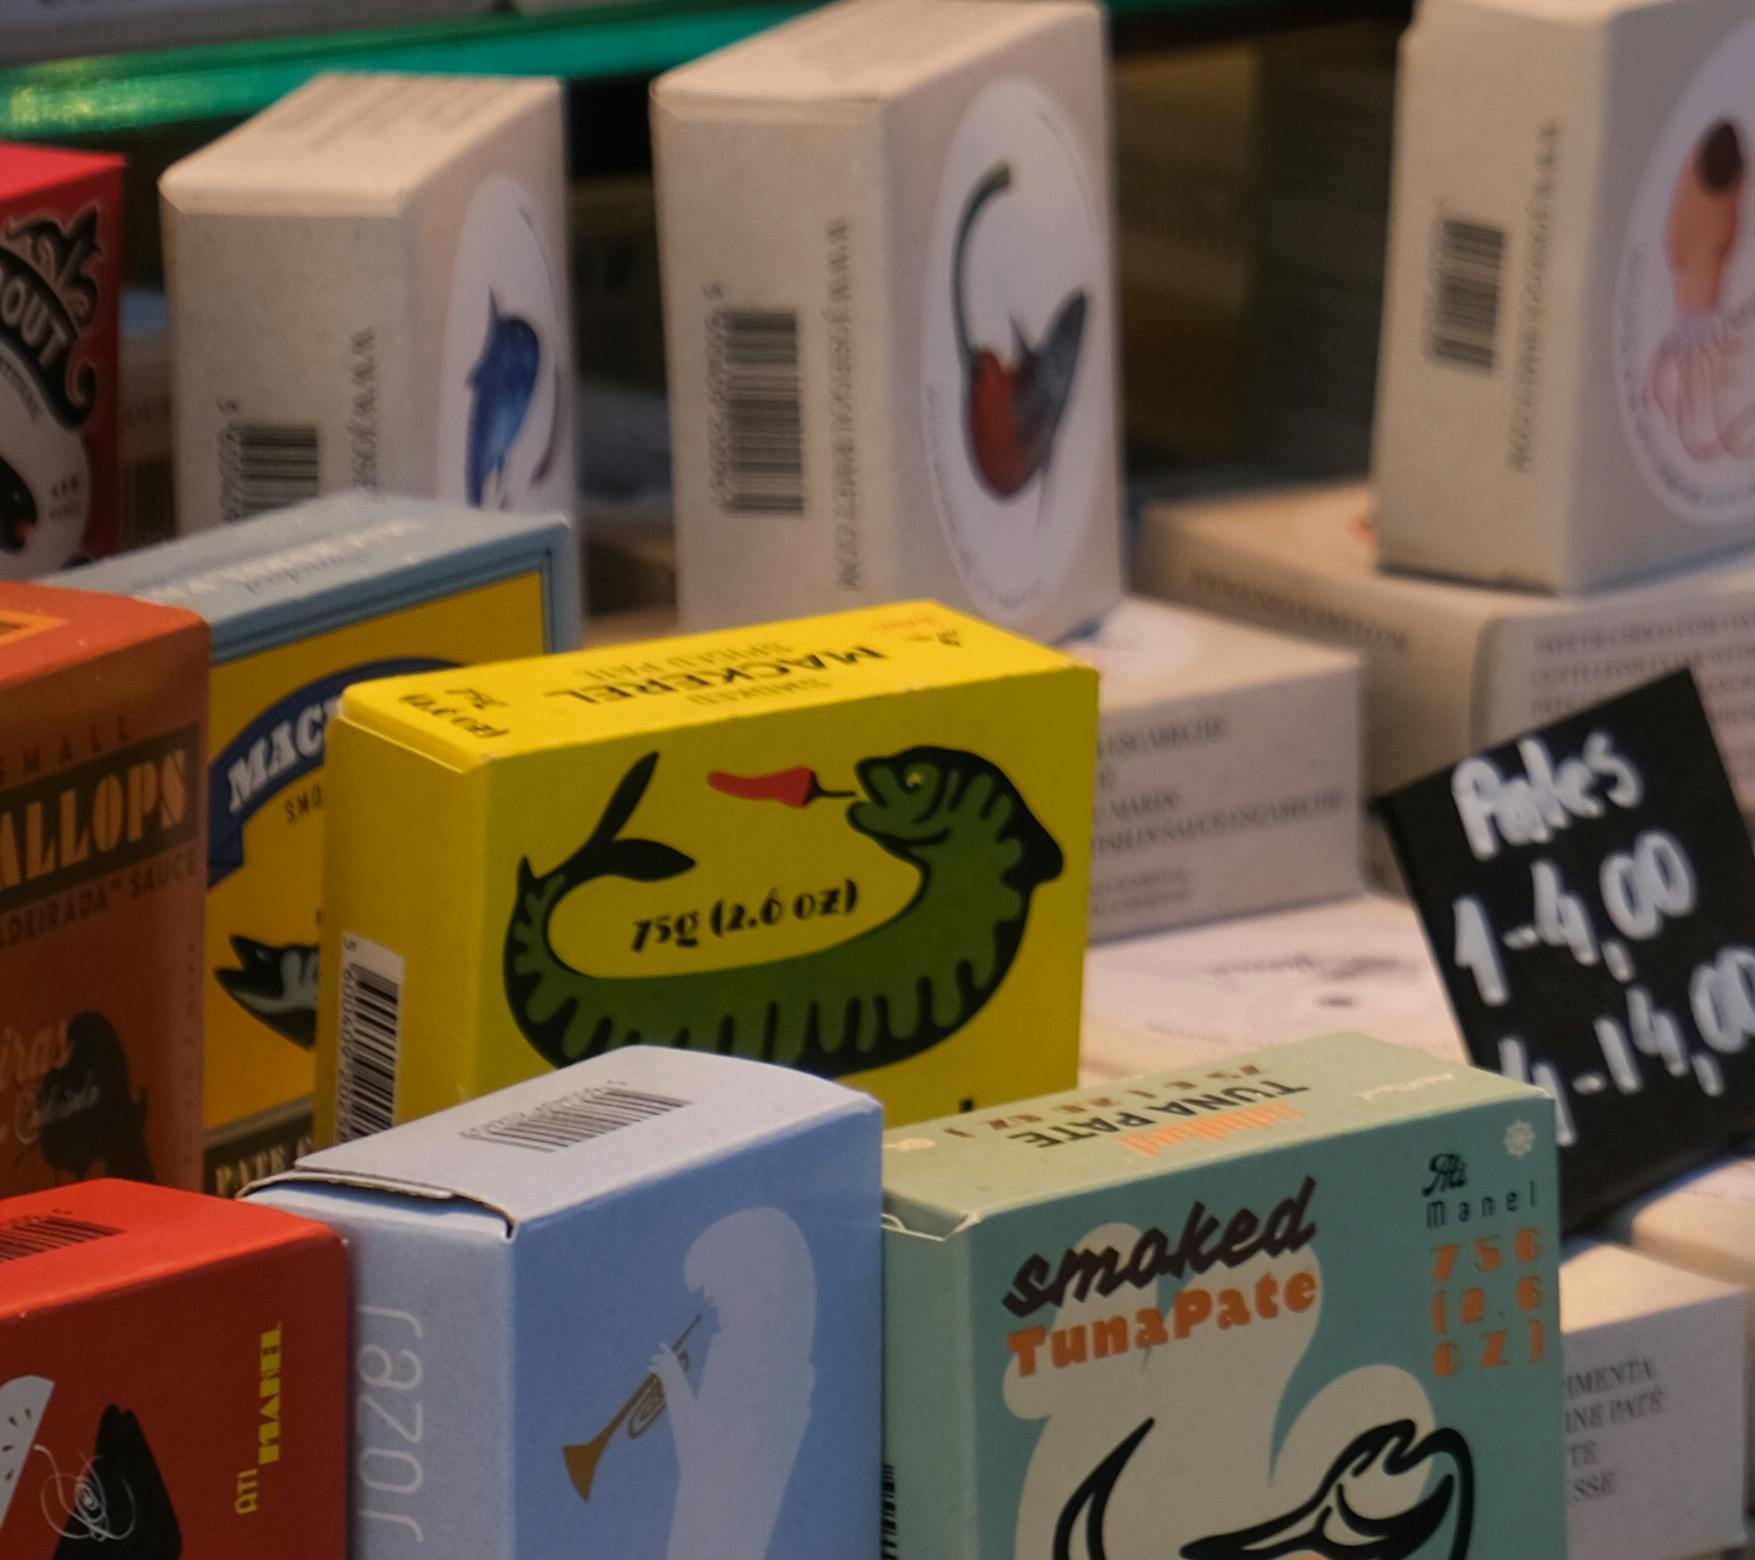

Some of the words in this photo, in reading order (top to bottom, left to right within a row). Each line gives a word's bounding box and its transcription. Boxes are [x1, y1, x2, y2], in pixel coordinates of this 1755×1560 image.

[0, 276, 70, 368] OUT
[545, 644, 888, 704] MACKEREL
[0, 714, 130, 776] MALL
[631, 900, 700, 954] 75g
[711, 882, 783, 941] (2.6
[796, 876, 861, 924] oz)
[1009, 1109, 1143, 1150] PATE
[1149, 1077, 1309, 1120] TUNA
[1425, 1179, 1540, 1230] Manel
[1002, 1175, 1319, 1319] smoked
[258, 1322, 284, 1466] MANEL
[1565, 1356, 1656, 1398] IMENTA
[358, 1302, 426, 1545] razor
